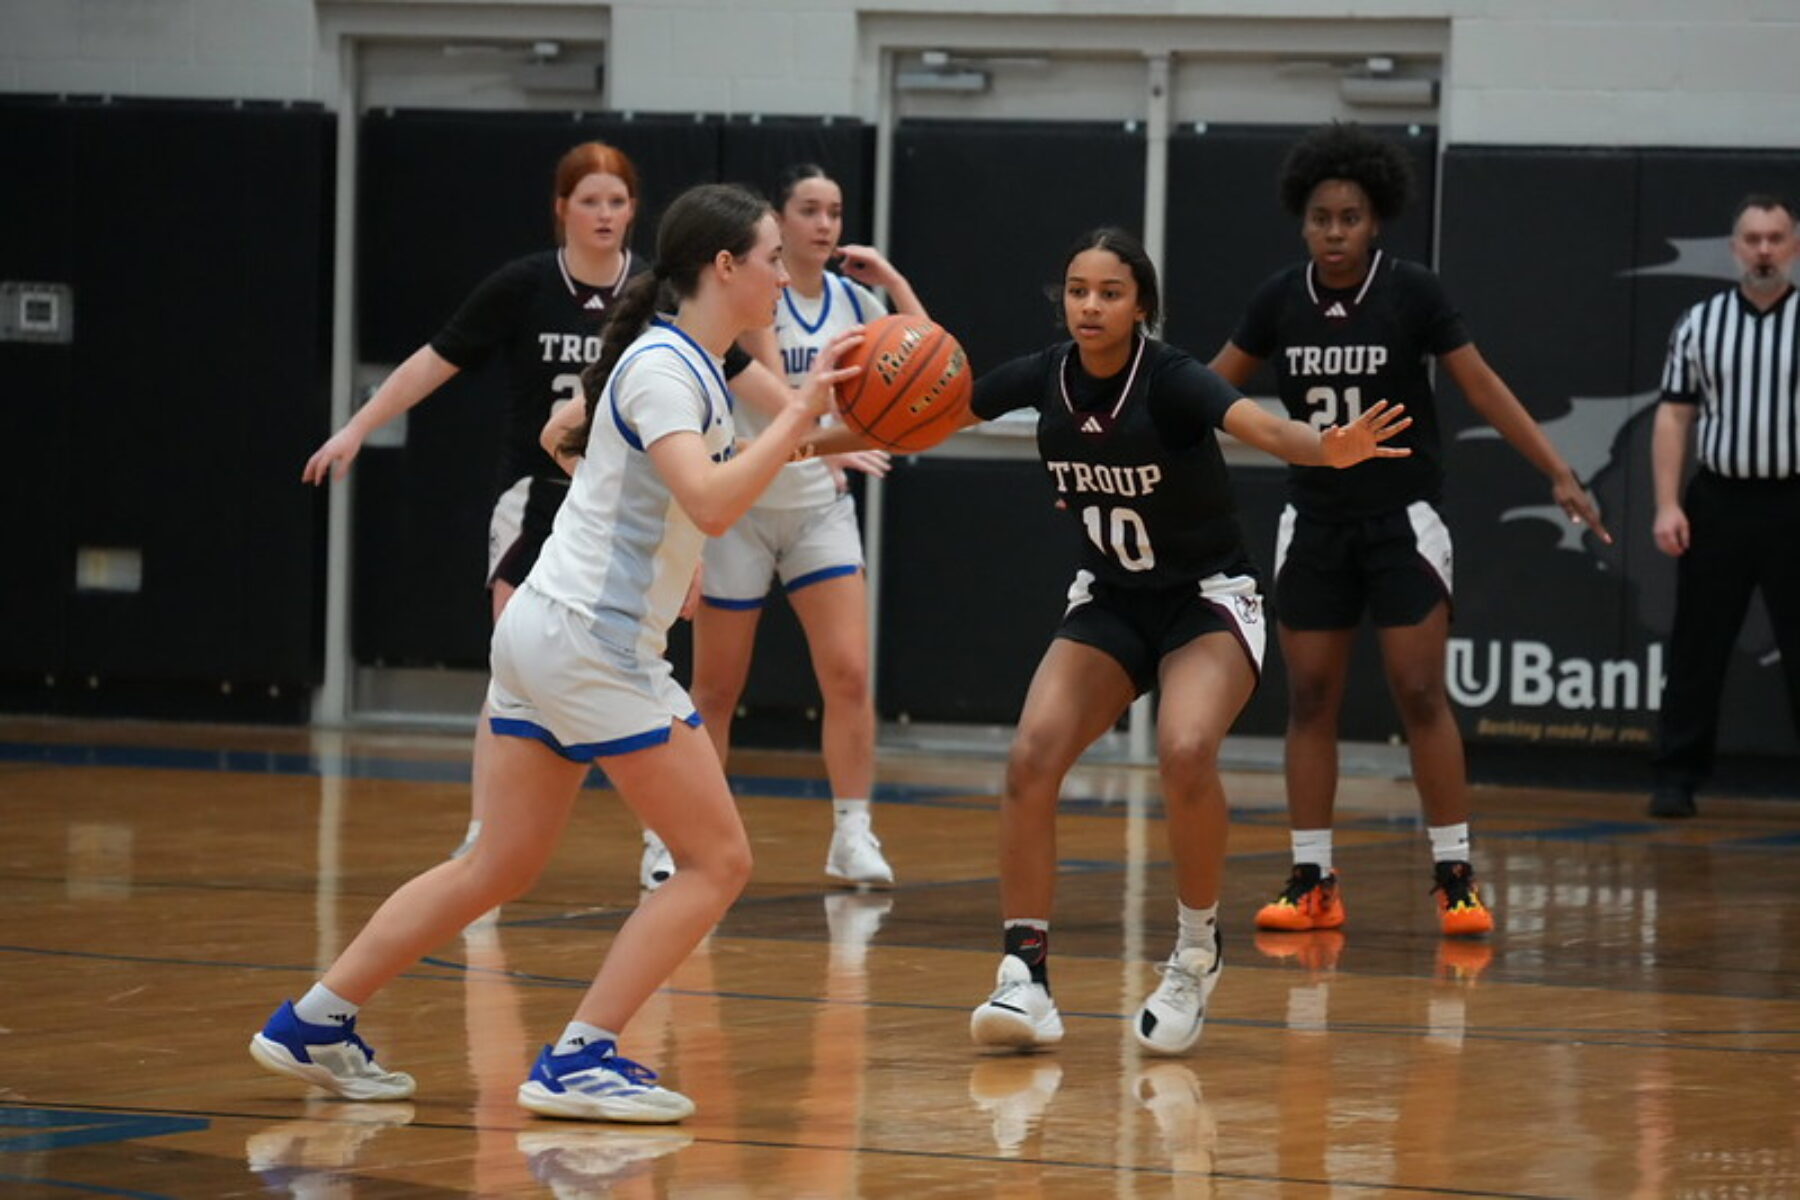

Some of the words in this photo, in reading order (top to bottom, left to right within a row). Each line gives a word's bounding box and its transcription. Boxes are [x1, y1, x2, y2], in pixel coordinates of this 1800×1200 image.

[1286, 346, 1387, 376] TROUP
[1306, 386, 1361, 432] 21
[1047, 461, 1162, 497] TROUP
[1083, 505, 1155, 572] 10
